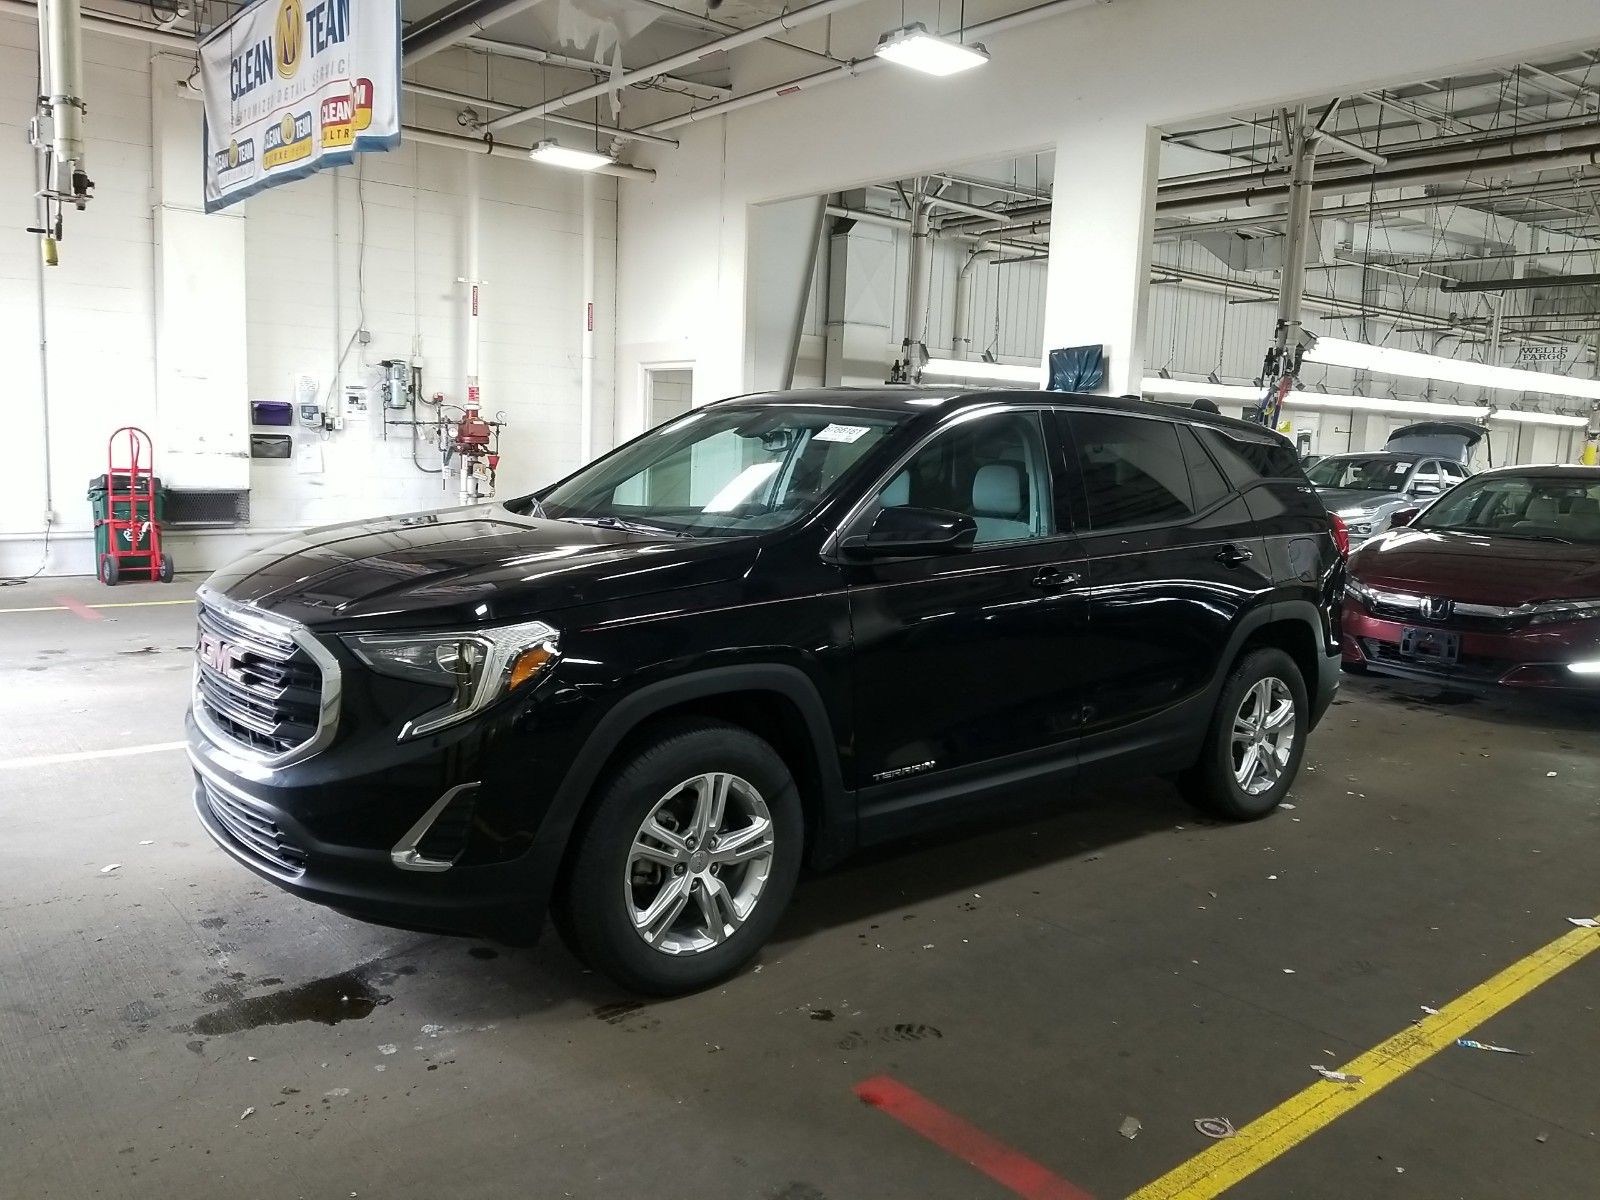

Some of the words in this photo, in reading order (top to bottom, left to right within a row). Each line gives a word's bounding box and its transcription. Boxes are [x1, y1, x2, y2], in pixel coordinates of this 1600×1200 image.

[231, 36, 273, 101] CLEAN
[322, 100, 352, 123] CLEAN
[1521, 346, 1569, 354] WELLS
[1522, 353, 1567, 361] FARGO
[200, 632, 246, 684] GMC
[873, 760, 936, 780] TERRAIN
